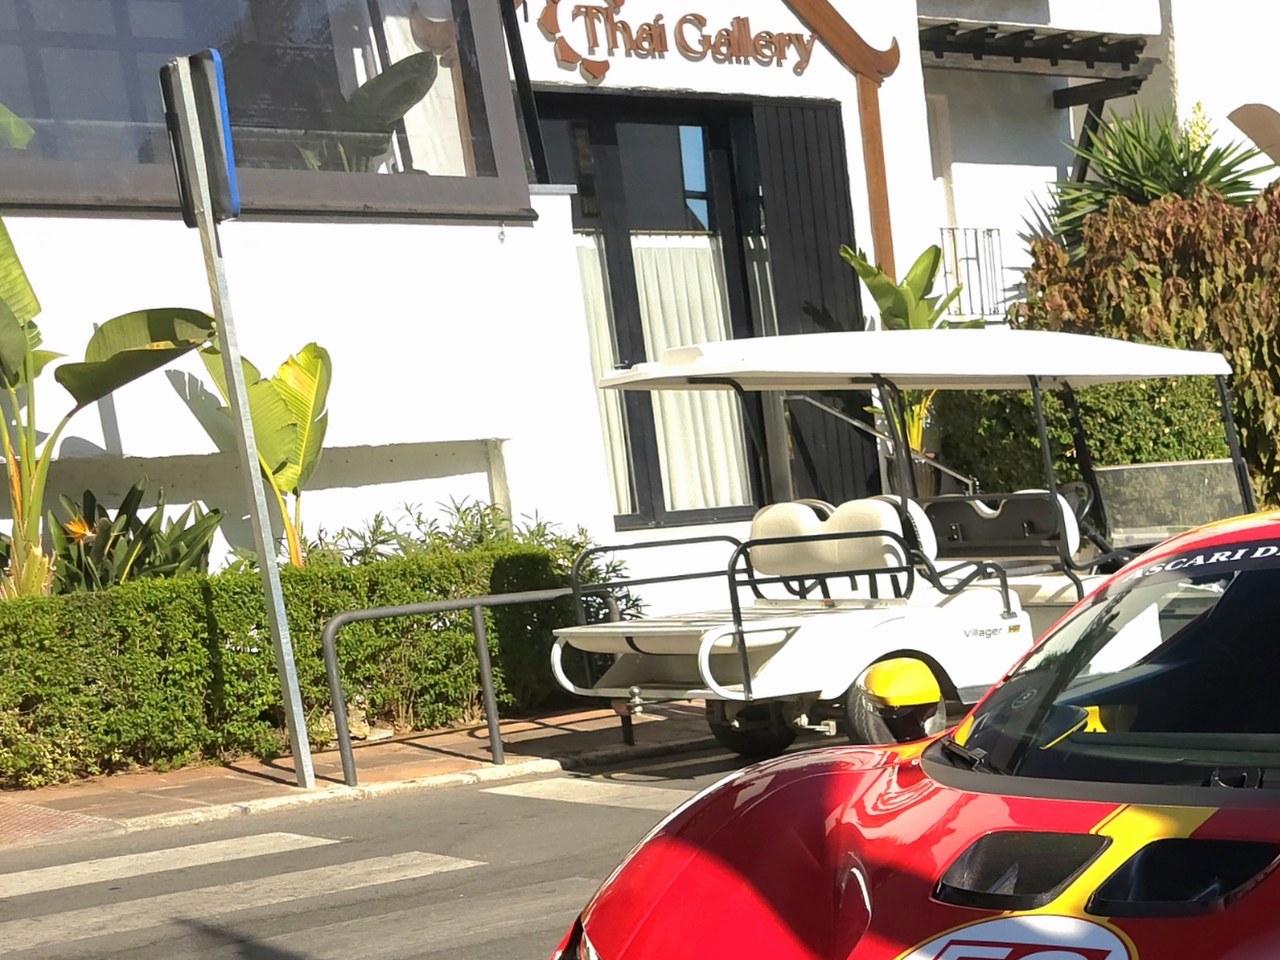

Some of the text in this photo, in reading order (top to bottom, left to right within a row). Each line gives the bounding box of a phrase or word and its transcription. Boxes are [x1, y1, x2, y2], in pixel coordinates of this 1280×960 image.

[572, 5, 818, 76] Thai Gallery
[1122, 548, 1249, 582] ASCARI
[963, 627, 1002, 638] Villager
